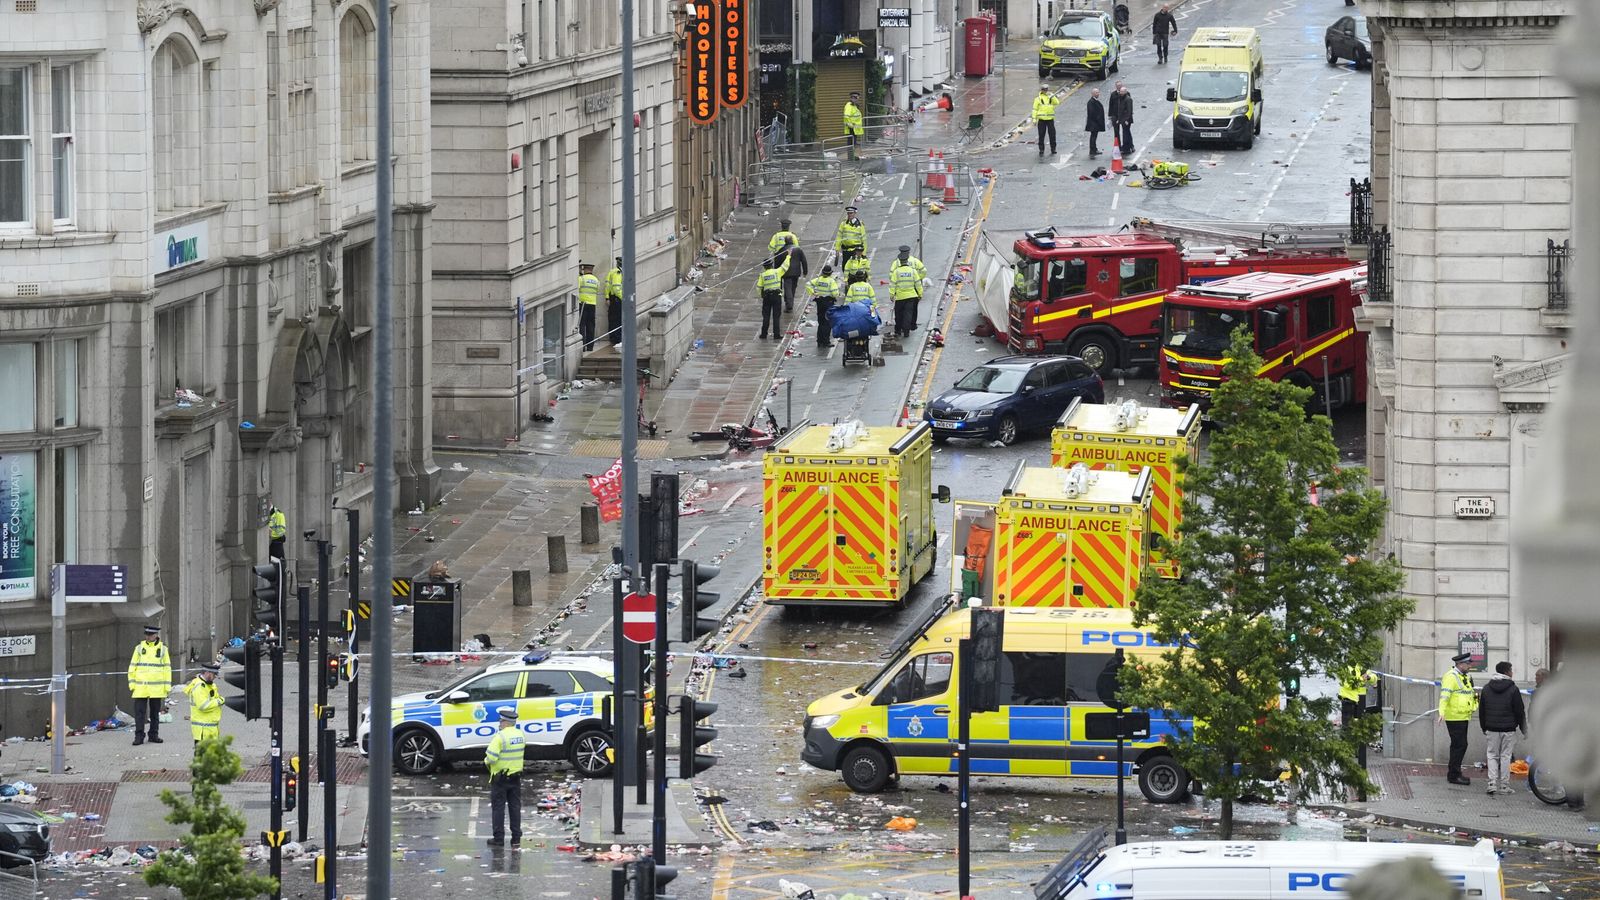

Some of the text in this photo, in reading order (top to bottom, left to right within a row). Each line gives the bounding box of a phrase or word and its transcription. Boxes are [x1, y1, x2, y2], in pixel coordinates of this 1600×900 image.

[727, 0, 739, 101] HOOTERS
[697, 5, 710, 116] HOOTERS
[1071, 447, 1167, 463] AMBULANCE
[783, 471, 880, 484] AMBULANCE
[11, 456, 20, 559] FREE CONSULTATION
[1020, 516, 1121, 533] AMBULANCE
[10, 638, 33, 646] DOCK
[456, 721, 563, 738] POICE
[1289, 872, 1466, 893] POE
